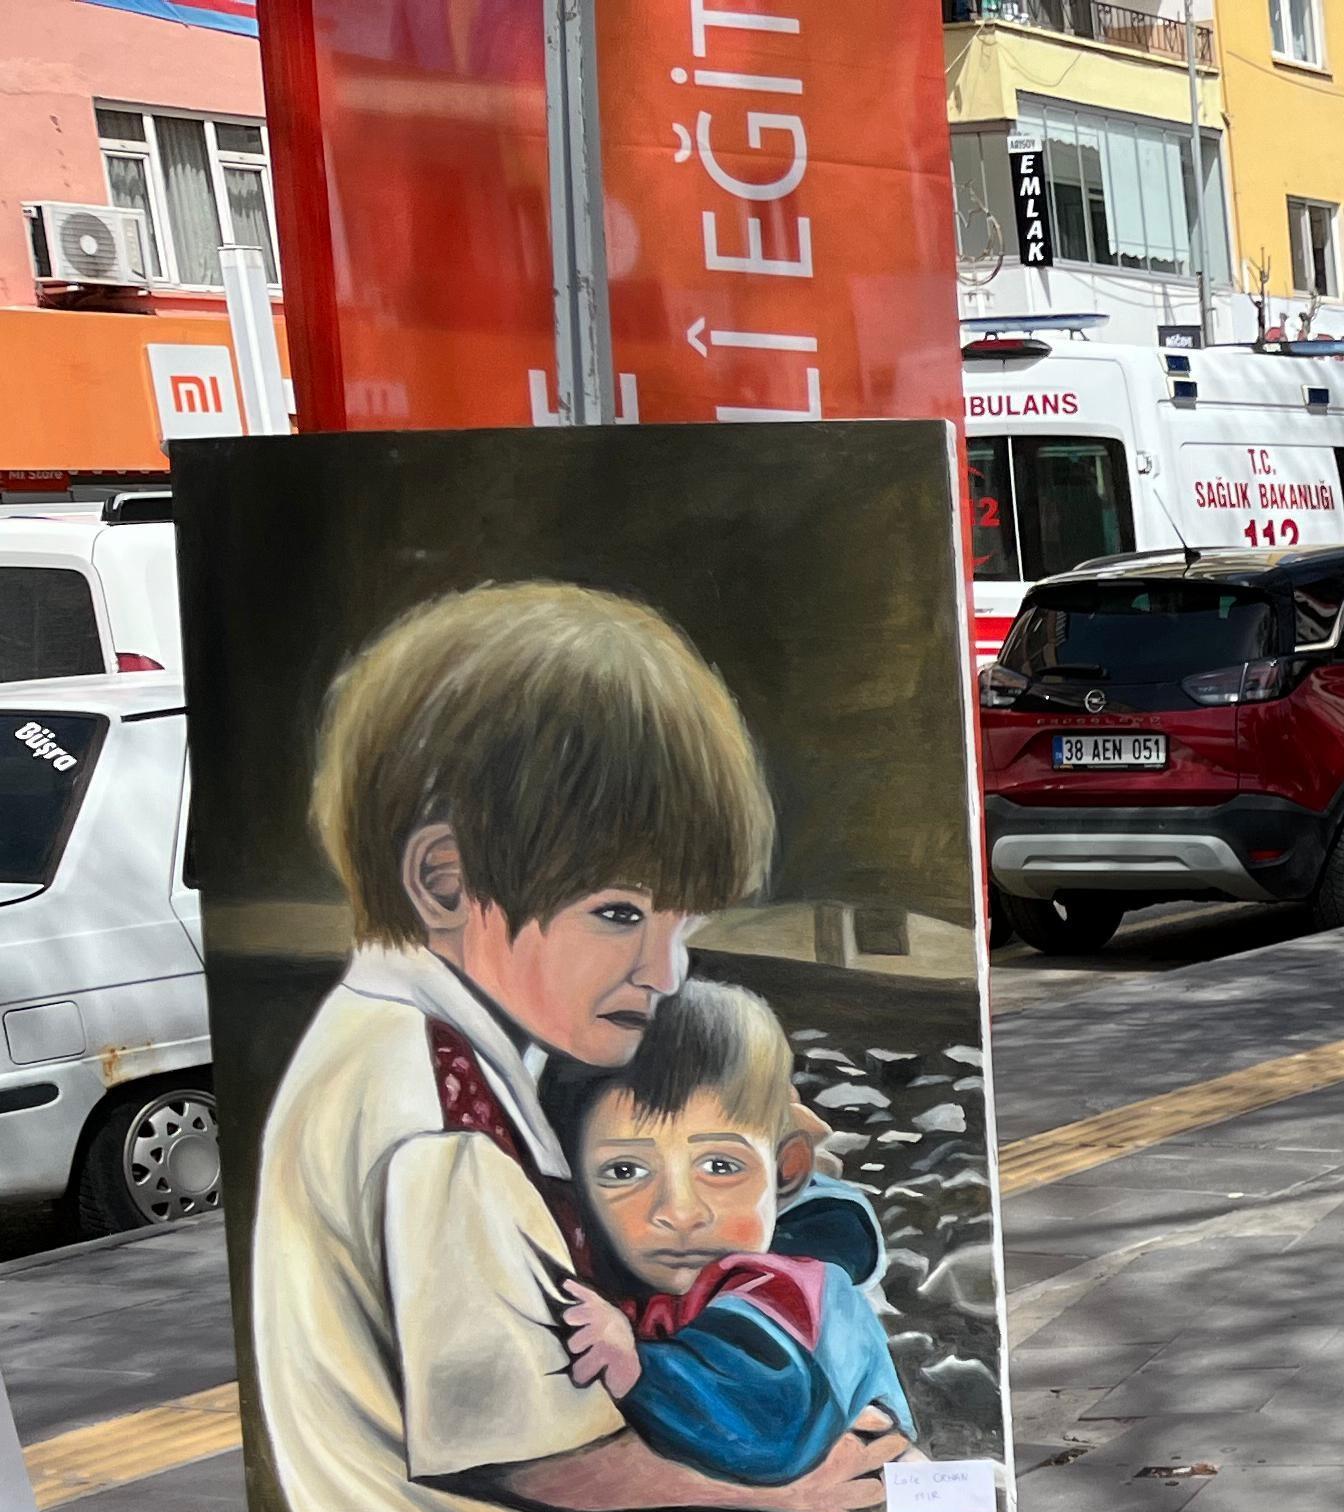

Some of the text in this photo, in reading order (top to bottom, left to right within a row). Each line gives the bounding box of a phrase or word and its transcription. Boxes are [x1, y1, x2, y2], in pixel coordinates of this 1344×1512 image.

[1020, 154, 1044, 262] EMLAK
[1247, 448, 1277, 475] T.C.
[1194, 476, 1336, 512] SAĞLIK BAKANLIĞI
[1244, 518, 1300, 548] 112
[15, 721, 77, 772] Büşra
[1065, 738, 1160, 761] 38 AEN 051
